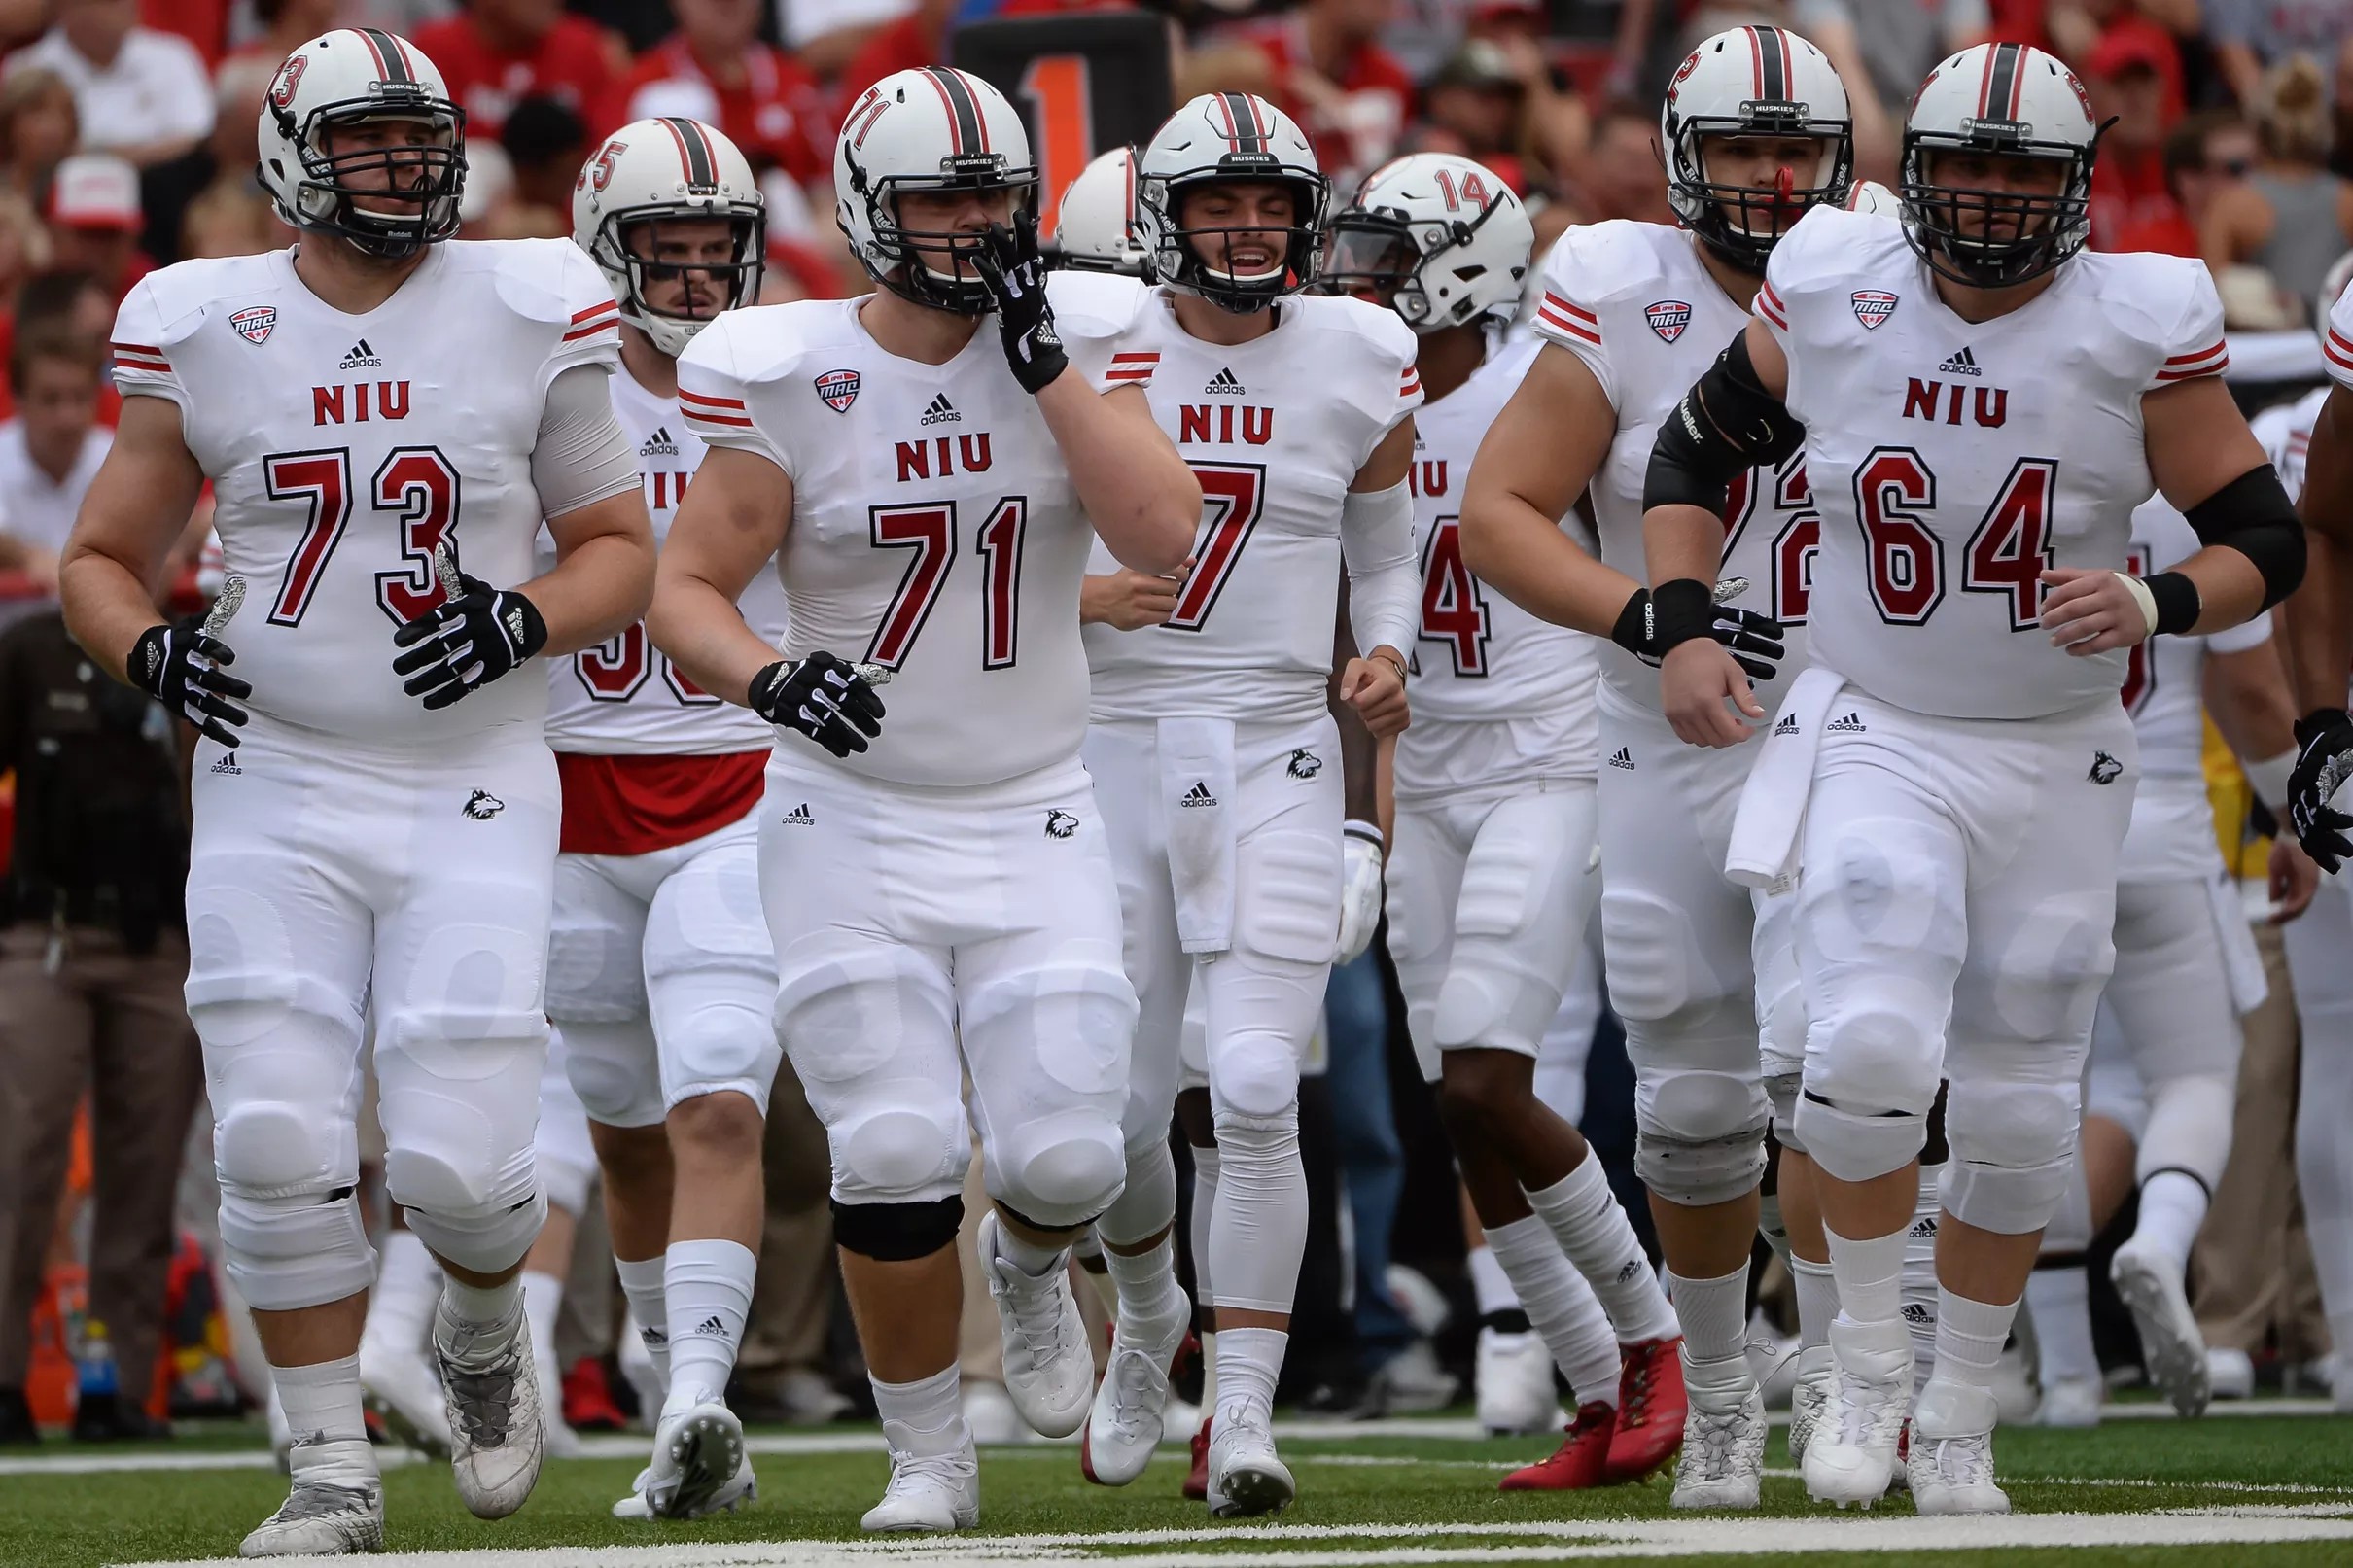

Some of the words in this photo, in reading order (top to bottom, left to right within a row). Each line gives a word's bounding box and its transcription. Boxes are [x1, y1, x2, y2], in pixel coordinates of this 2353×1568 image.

[382, 83, 418, 91] HUSKIES
[842, 87, 891, 151] 71
[1975, 122, 2017, 132] HUSKIES
[1018, 53, 1095, 249] 1
[955, 157, 993, 166] HUSKIES
[1434, 168, 1493, 214] 14
[1853, 300, 1895, 314] MAC
[235, 316, 276, 332] MAC
[1649, 312, 1690, 328] MAC
[339, 356, 382, 370] adidas
[1939, 363, 1982, 377] adidas
[820, 380, 860, 398] MAC
[1205, 384, 1246, 396] adidas
[311, 380, 411, 427] NIU
[1902, 376, 2009, 429] NIU
[920, 411, 962, 426] adidas
[1179, 404, 1274, 446] NIU
[639, 444, 679, 457] adidas
[895, 432, 993, 482] NIU
[263, 445, 462, 629] 73
[1851, 445, 2059, 633] 64
[1159, 459, 1267, 633] 7
[861, 495, 1027, 673] 71
[1408, 515, 1492, 678] 4
[1645, 602, 1655, 641] adidas
[1827, 722, 1867, 733] adidas
[210, 764, 242, 775] adidas
[1608, 757, 1635, 771] adidas
[1180, 797, 1217, 808] adidas
[782, 815, 815, 825] adidas
[1909, 1229, 1938, 1238] adid
[695, 1327, 730, 1337] adidas
